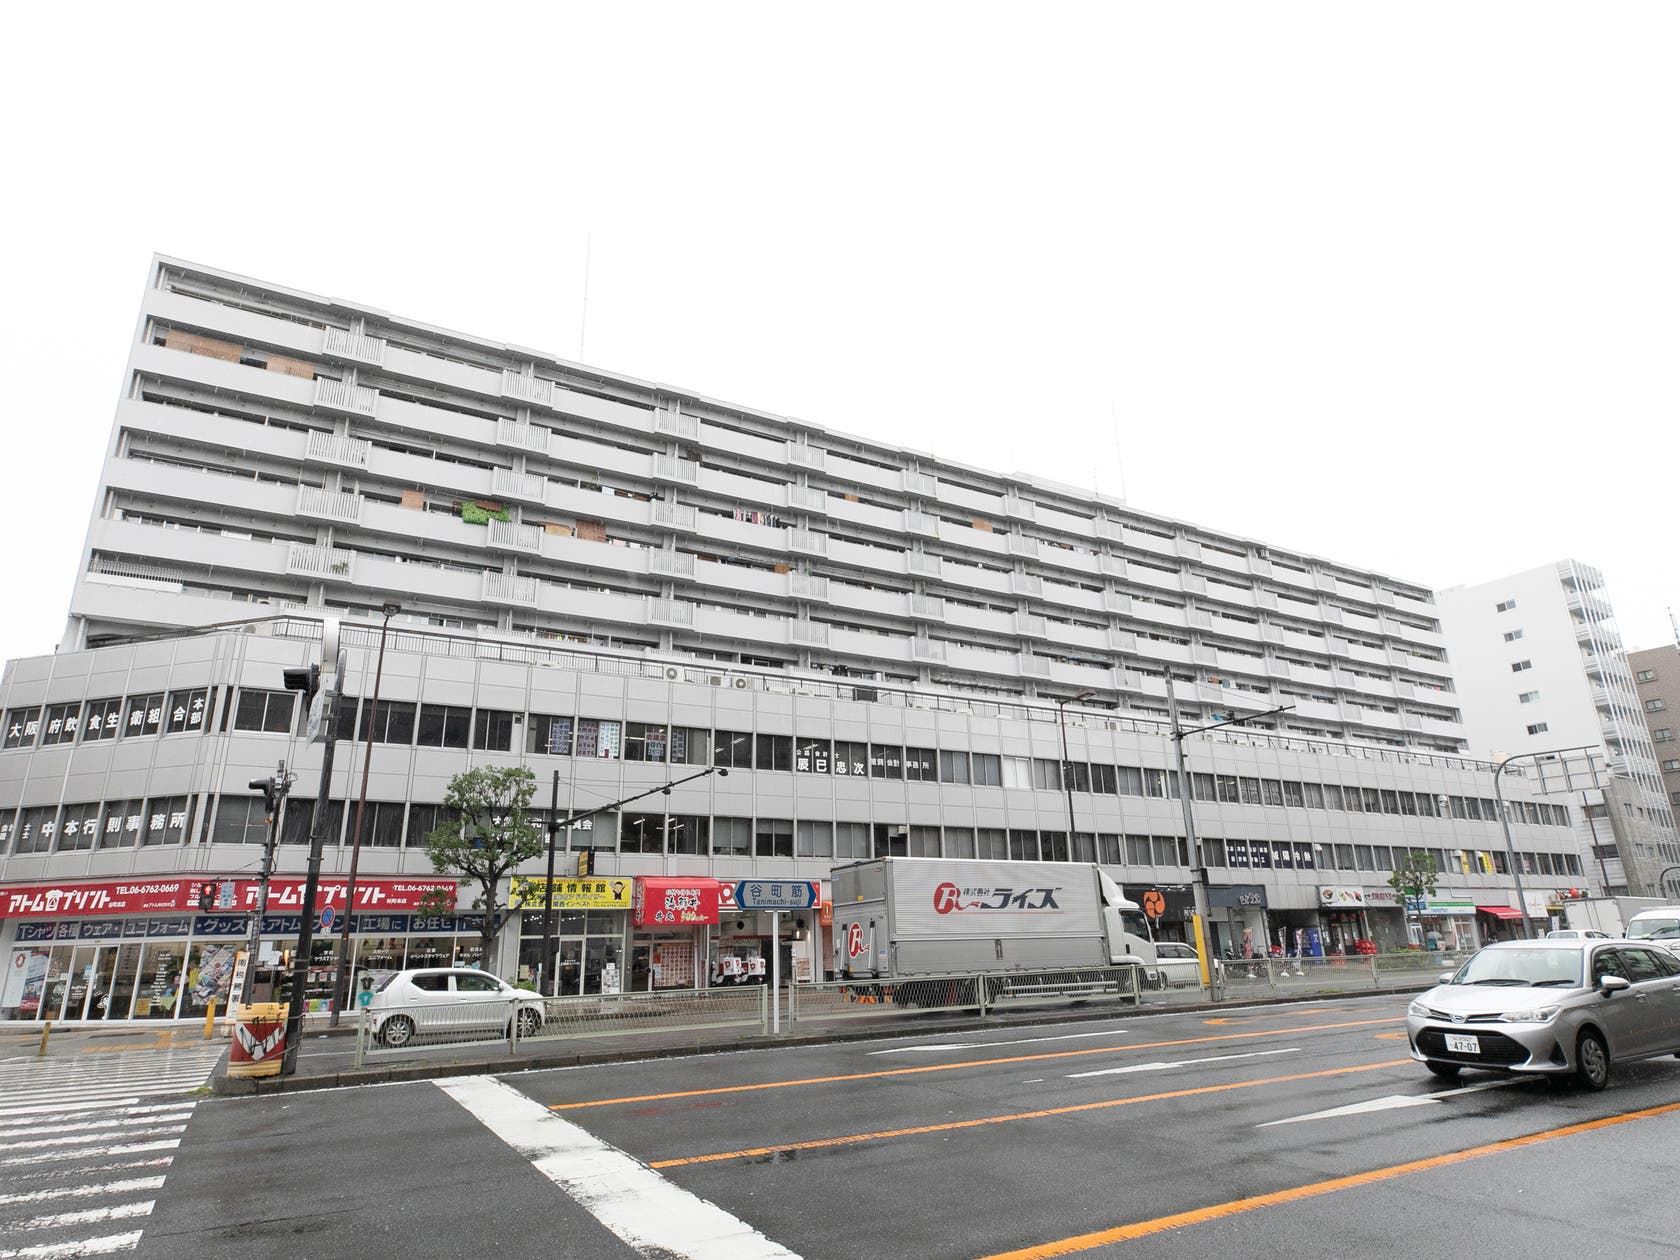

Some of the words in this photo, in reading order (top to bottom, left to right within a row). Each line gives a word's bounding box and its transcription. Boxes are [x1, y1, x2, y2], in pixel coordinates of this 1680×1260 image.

[190, 697, 205, 724] 本部
[797, 757, 865, 775] 辰巳忠次
[41, 811, 186, 838] 中本行則事務所
[116, 883, 180, 895] TEL.06-6762-0669
[750, 884, 802, 898] 谷町筋
[752, 897, 802, 907] Tanimachi-suji
[962, 887, 991, 897] 株式会社
[980, 887, 1063, 909] ライズ
[1453, 1041, 1477, 1052] 47-07
